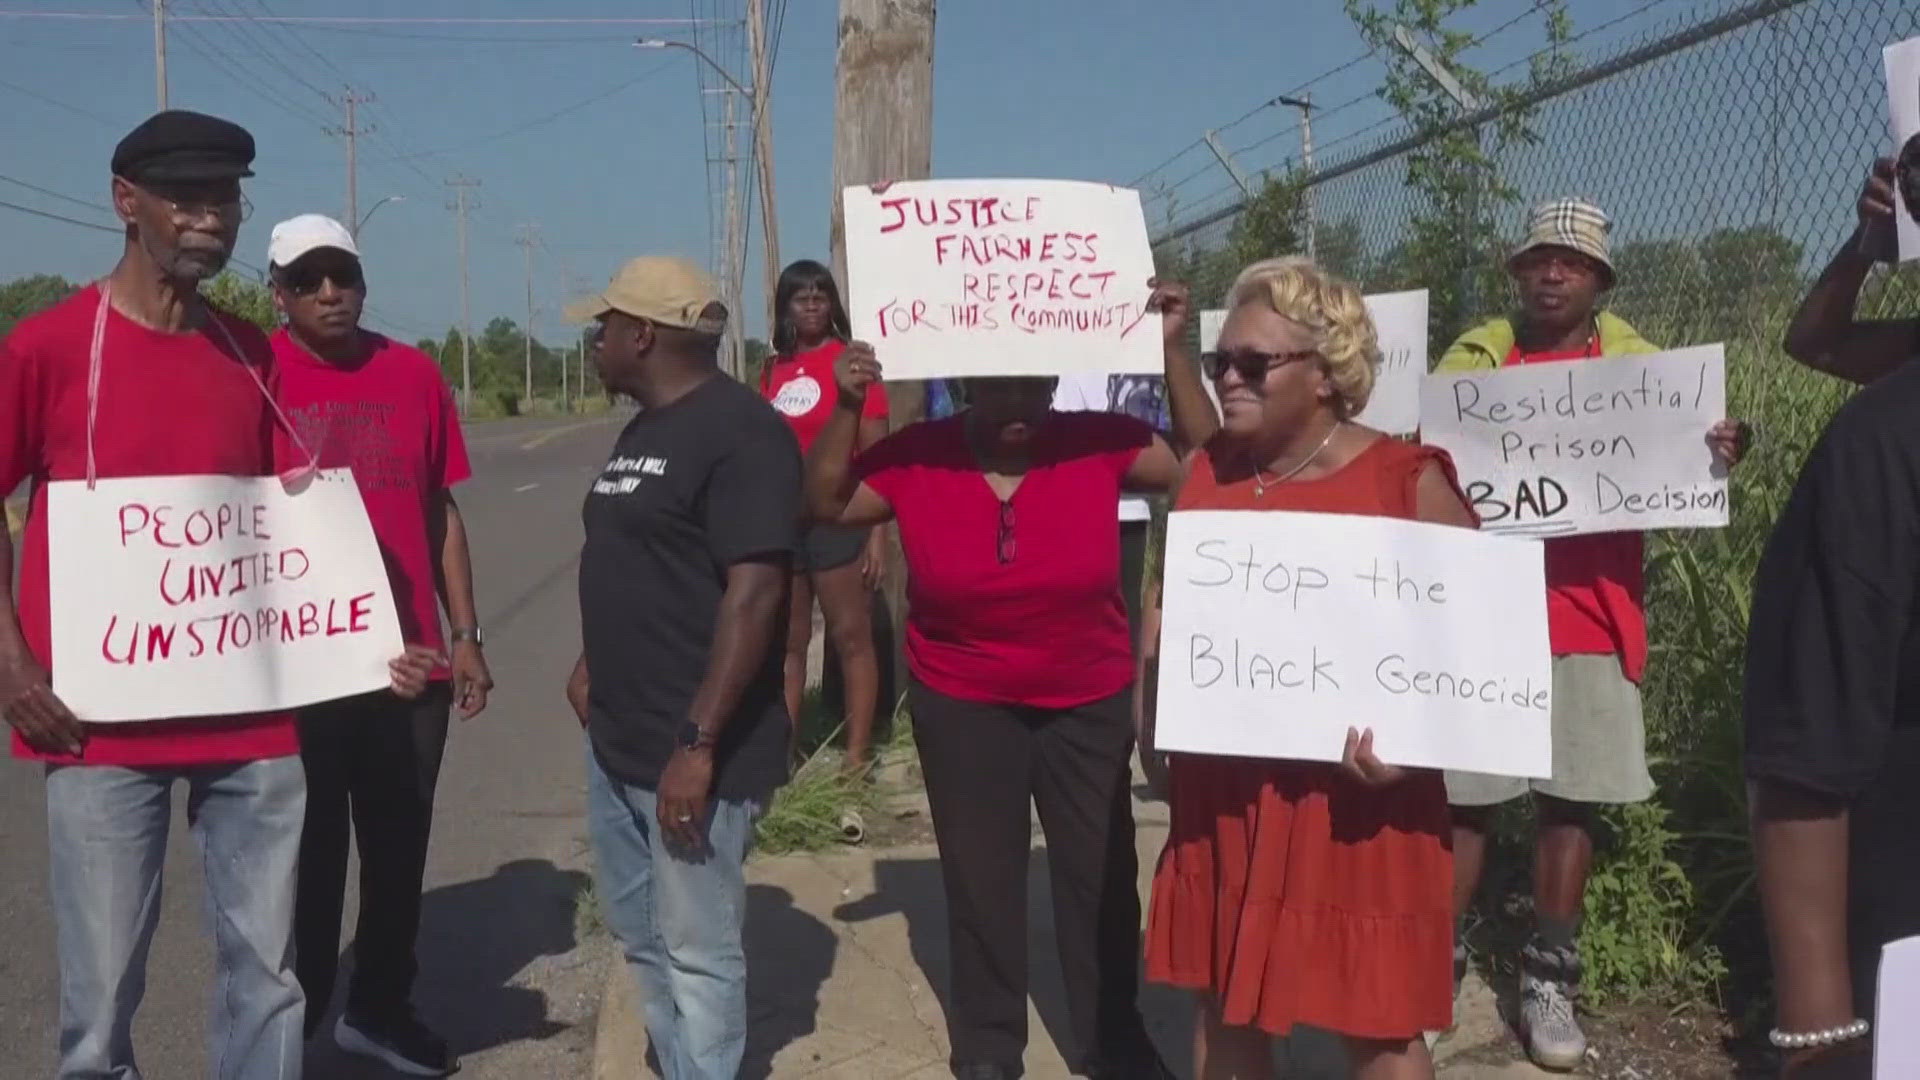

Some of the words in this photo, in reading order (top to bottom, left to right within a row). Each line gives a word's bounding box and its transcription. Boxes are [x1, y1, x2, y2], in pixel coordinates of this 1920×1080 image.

[880, 197, 1040, 234] JUSTICE
[935, 233, 1098, 266] FAIRNESS
[963, 269, 1117, 302] RESPECT
[942, 302, 999, 332] THIS
[1453, 363, 1706, 423] Residential
[1502, 431, 1636, 464] Prison
[1466, 476, 1569, 522] BAD
[1596, 471, 1727, 515] Decision
[118, 503, 271, 548] PEOPLE
[159, 548, 310, 606] UNITED
[1187, 540, 1329, 611] Stop
[1354, 557, 1447, 605] the
[101, 592, 376, 666] UNSTOPPABLE
[1375, 654, 1549, 712] Genocide
